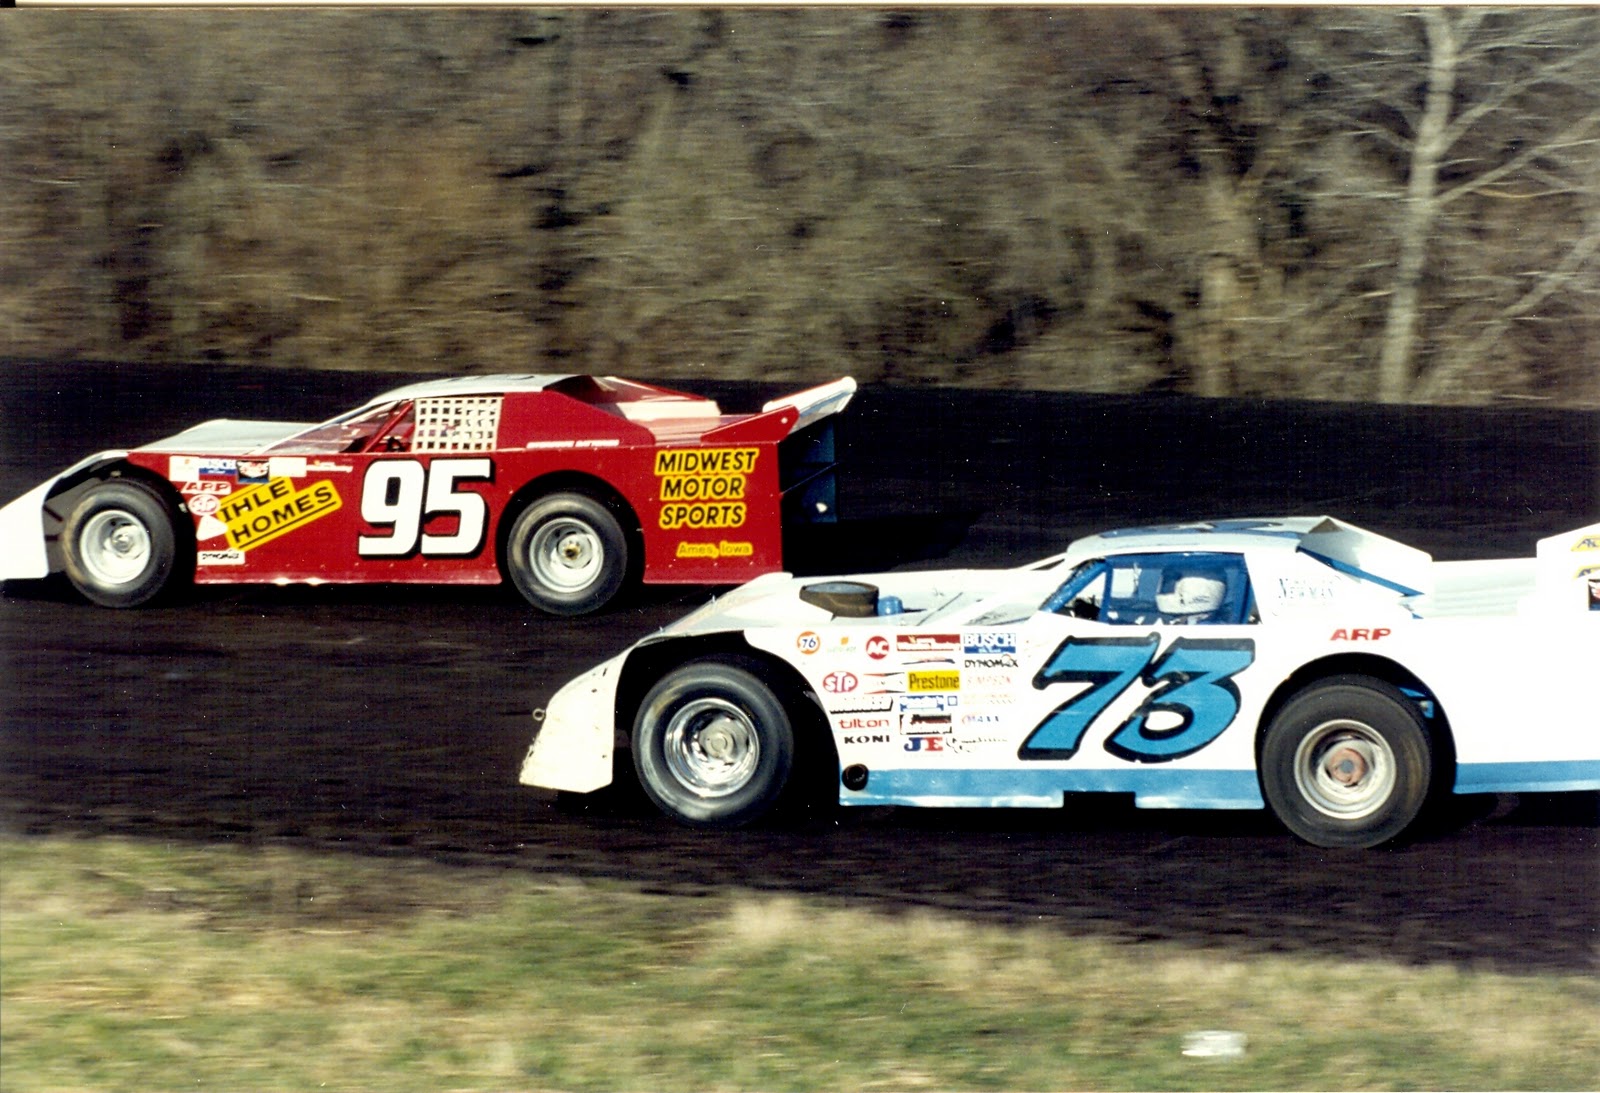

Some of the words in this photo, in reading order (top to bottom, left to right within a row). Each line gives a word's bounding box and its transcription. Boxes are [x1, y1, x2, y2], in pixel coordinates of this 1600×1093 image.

[657, 450, 757, 473] MIDWEST
[662, 476, 744, 498] MOTOR
[220, 480, 290, 522] IHLE
[358, 457, 496, 560] 95
[231, 485, 334, 544] HOMES
[661, 504, 744, 526] SPORTS
[720, 543, 752, 555] Iowa
[802, 637, 817, 648] 76
[964, 633, 1016, 646] BUSCH
[1330, 628, 1391, 641] ARP
[867, 640, 888, 654] AC
[824, 673, 857, 692] STP
[909, 673, 960, 689] Prestone
[1017, 632, 1255, 763] 73
[838, 718, 889, 729] tilton
[844, 735, 890, 744] KONI
[904, 737, 943, 752] JE
